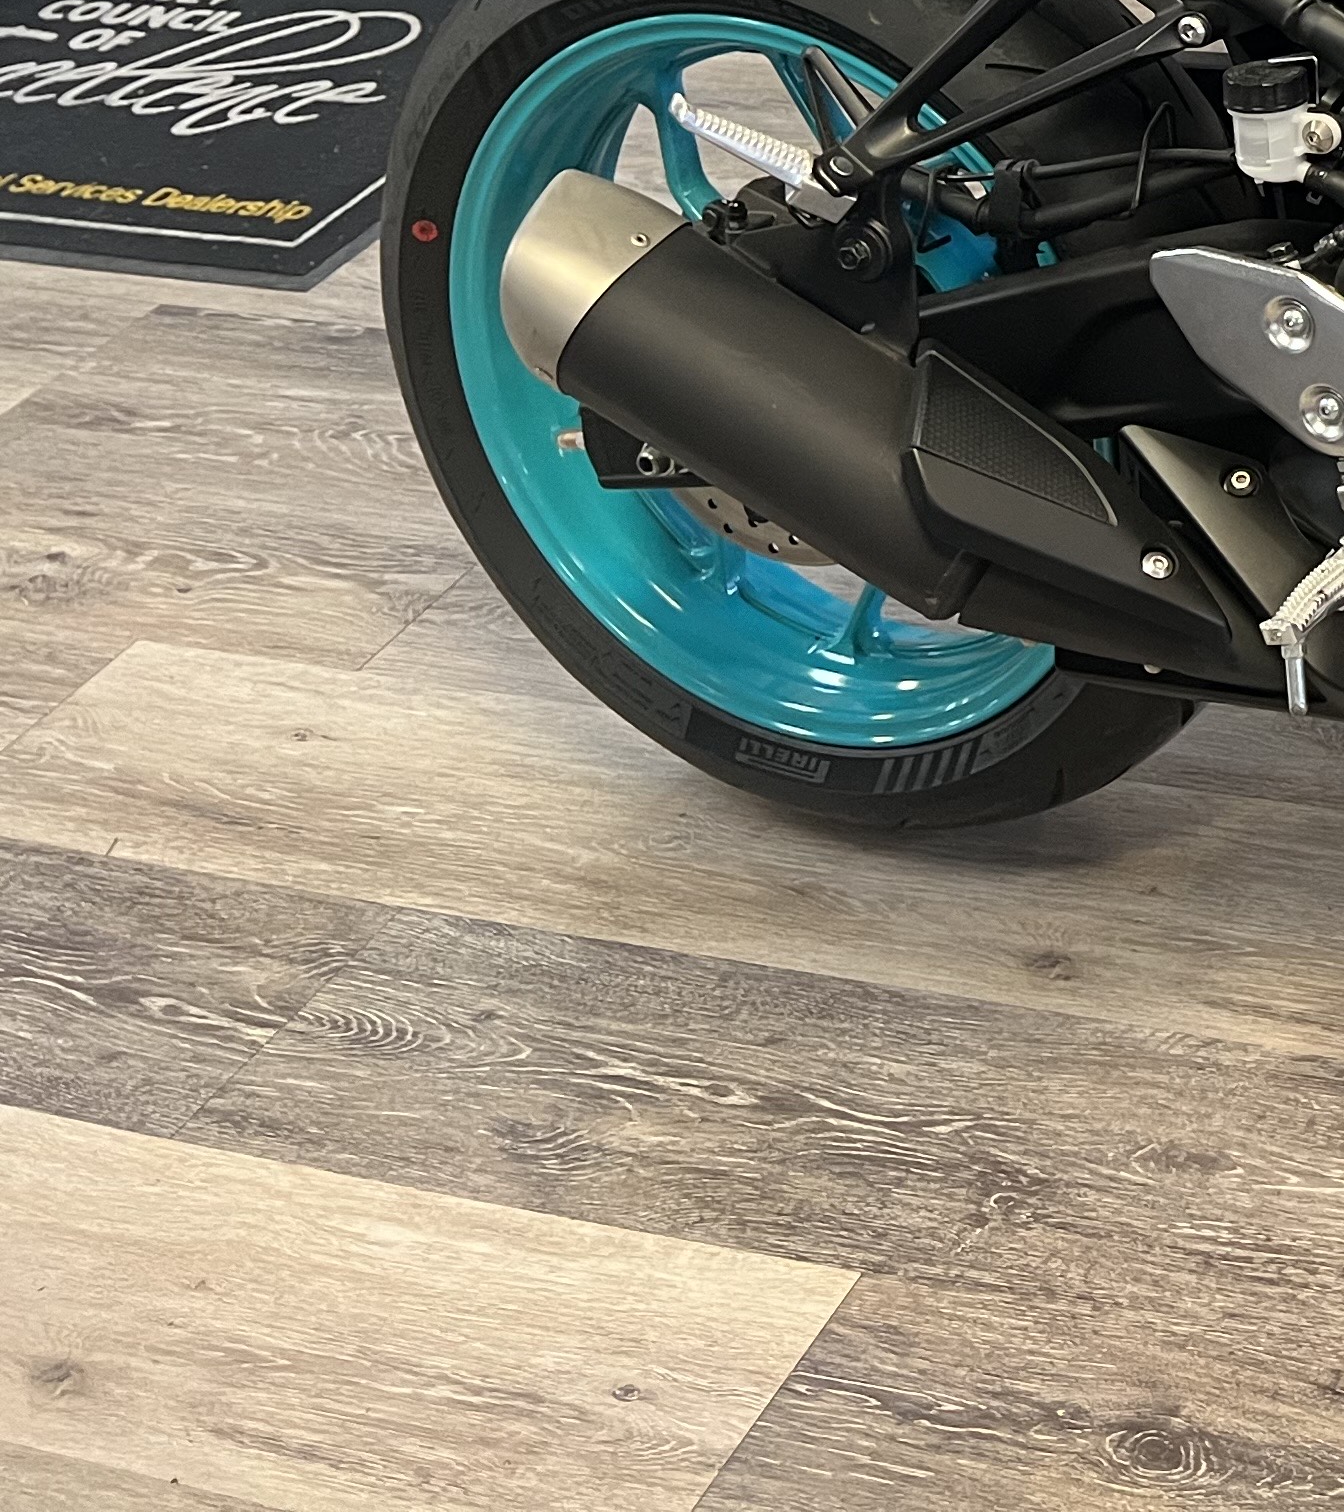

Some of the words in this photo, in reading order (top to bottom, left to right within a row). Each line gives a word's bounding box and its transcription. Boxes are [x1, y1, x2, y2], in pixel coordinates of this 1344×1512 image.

[69, 27, 147, 52] OF
[9, 173, 143, 204] Services
[141, 186, 313, 224] Dealership
[735, 737, 832, 786] PIRELLI
